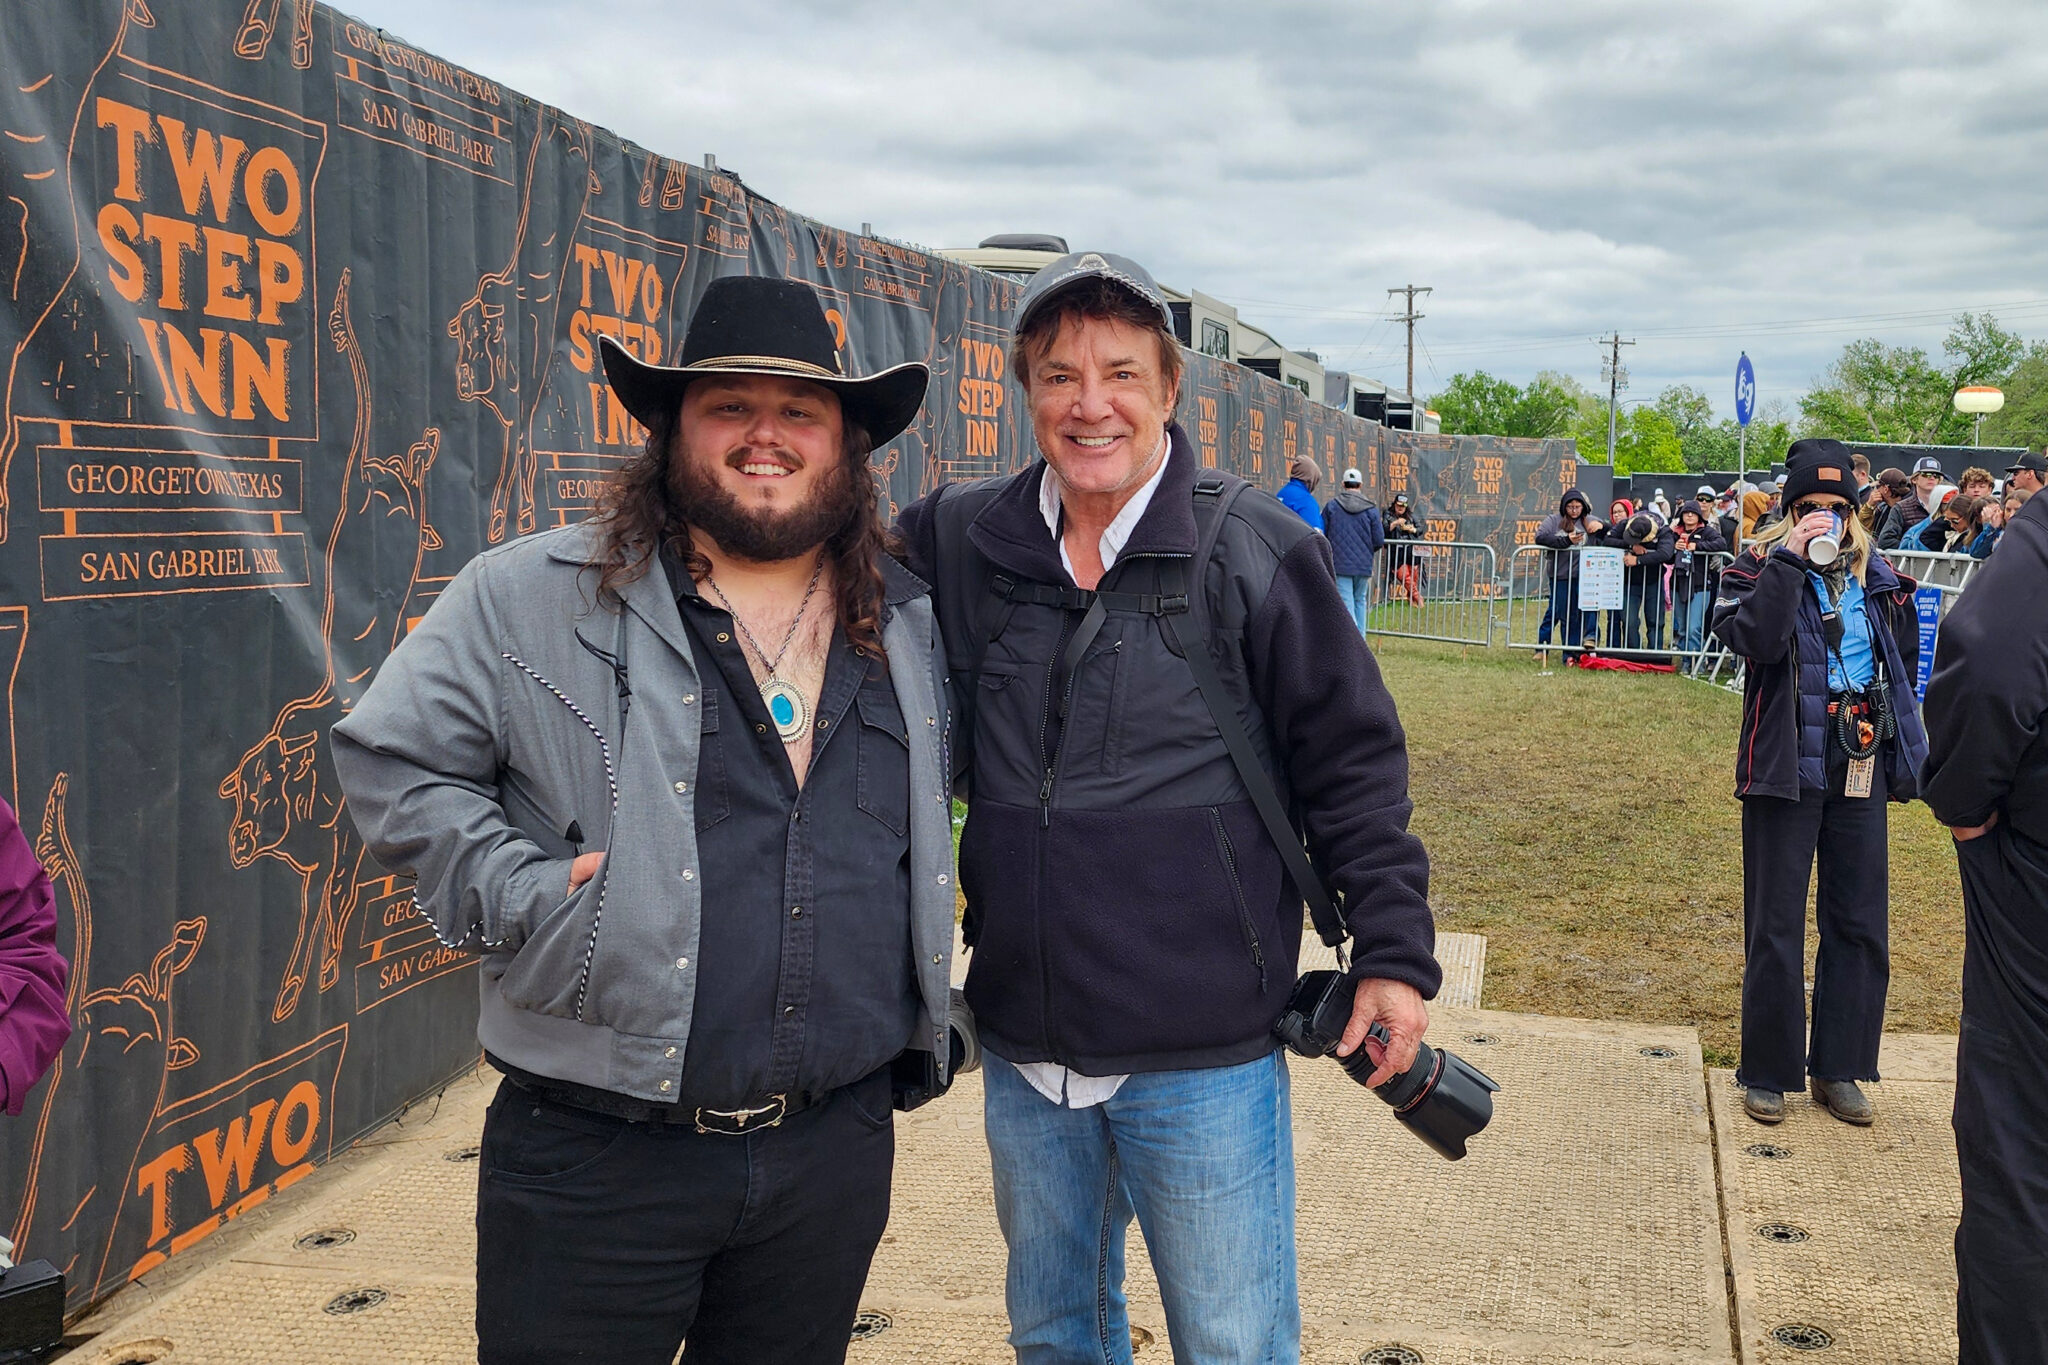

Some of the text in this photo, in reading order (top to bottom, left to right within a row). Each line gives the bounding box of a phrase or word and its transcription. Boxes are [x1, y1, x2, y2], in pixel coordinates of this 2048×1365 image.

[457, 69, 500, 106] TEXAS
[362, 98, 495, 167] SAN GABRIEL PARK
[97, 97, 303, 237] TWO
[97, 203, 304, 325] STEP
[575, 243, 663, 323] TWO
[961, 338, 1004, 380] TWO
[958, 377, 1004, 417] STEP
[966, 419, 998, 457] INN
[67, 463, 283, 500] GEORGETOWN, TEXAS
[1472, 468, 1503, 481] STEP
[1473, 456, 1504, 470] TWO
[1560, 459, 1577, 471] TW
[1477, 481, 1500, 494] INN
[1425, 519, 1457, 532] TWO
[1515, 532, 1536, 544] STE
[81, 548, 284, 583] SAN GABRIEL PARK
[380, 956, 415, 989] SAN
[137, 1080, 321, 1248] TWO
